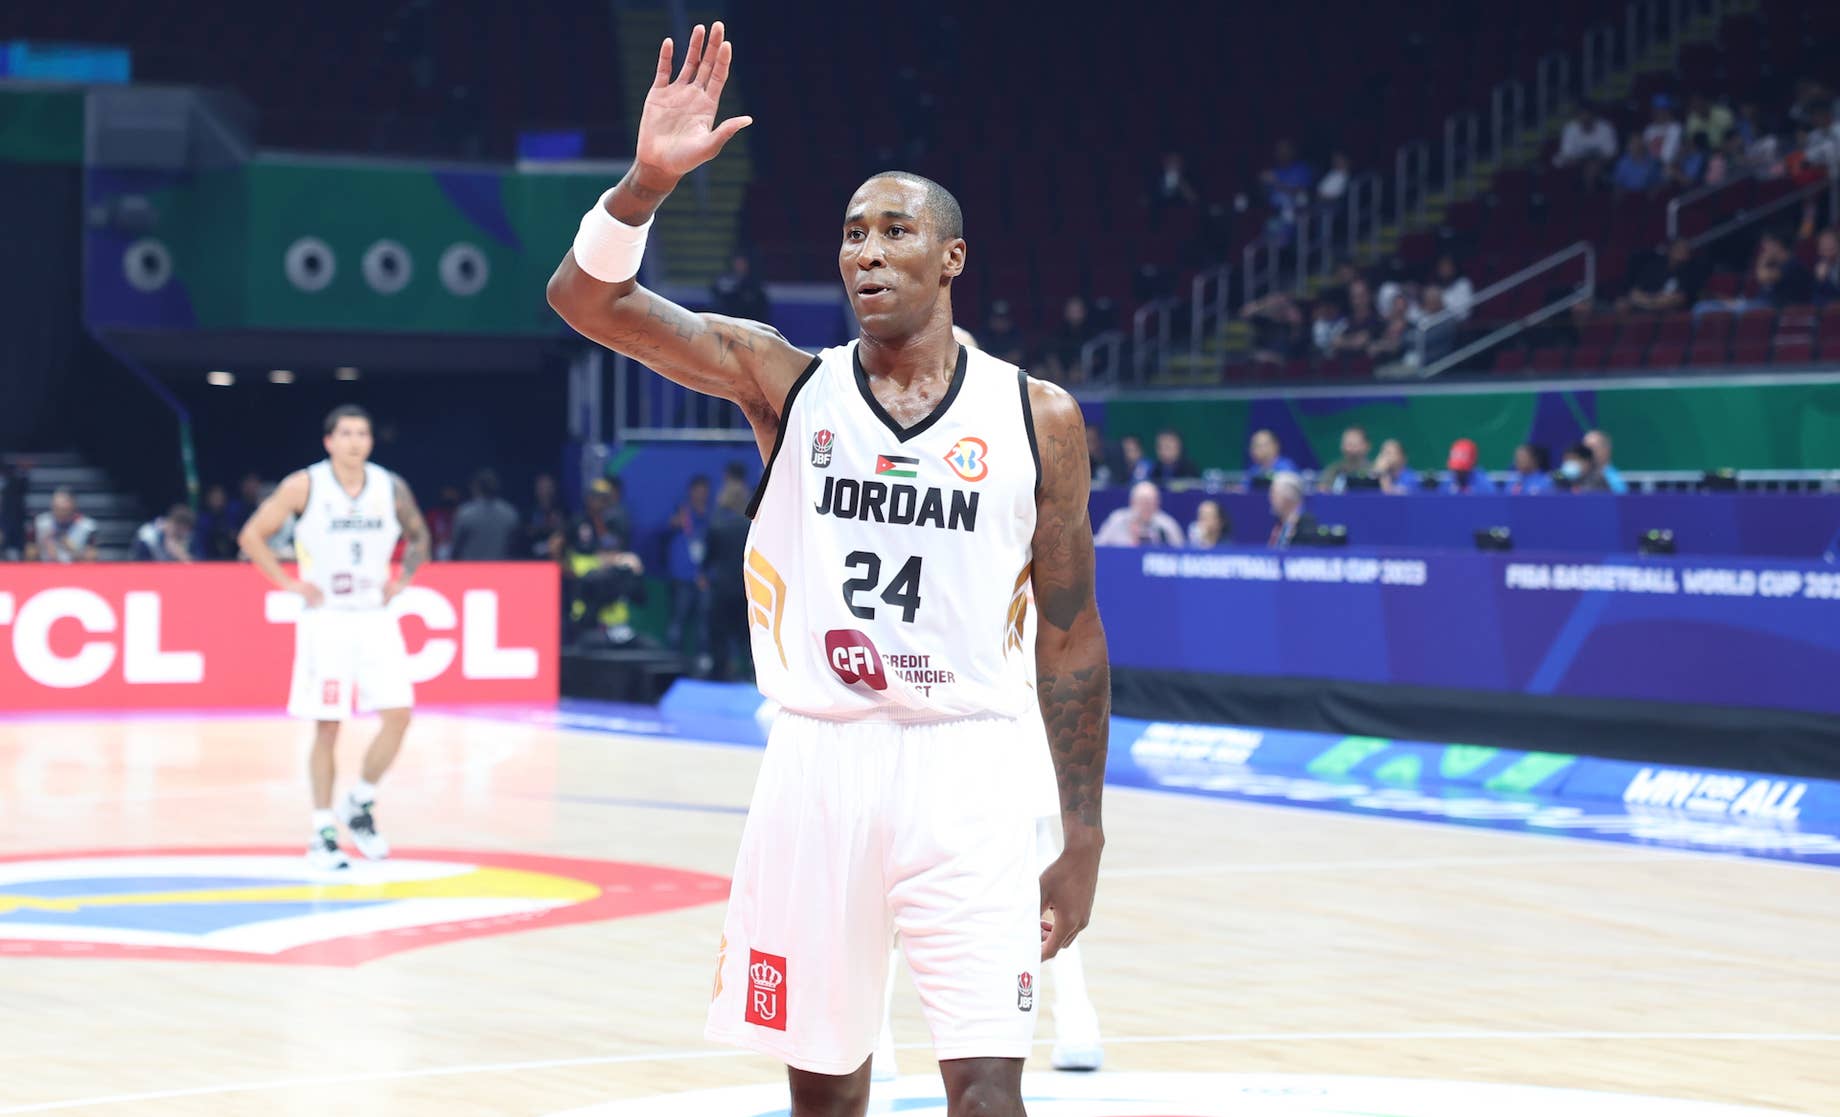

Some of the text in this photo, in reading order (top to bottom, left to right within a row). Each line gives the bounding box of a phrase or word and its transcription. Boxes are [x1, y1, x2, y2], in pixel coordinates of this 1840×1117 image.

[812, 452, 832, 465] JBF
[814, 476, 980, 532] JORDAN
[1180, 554, 1282, 580] BASKETBALL
[1284, 557, 1343, 583] WORLD
[1344, 558, 1379, 583] CUP
[1506, 563, 1549, 589] FIBA
[1552, 564, 1679, 594] BASKETBALL
[1682, 568, 1756, 597] WORLD
[1758, 569, 1802, 597] CUP
[842, 550, 923, 623] 24
[0, 586, 205, 688] CL
[832, 646, 876, 676] CFI
[1623, 768, 1701, 808] WIN
[1729, 779, 1808, 820] ALL
[753, 989, 777, 1020] RJ
